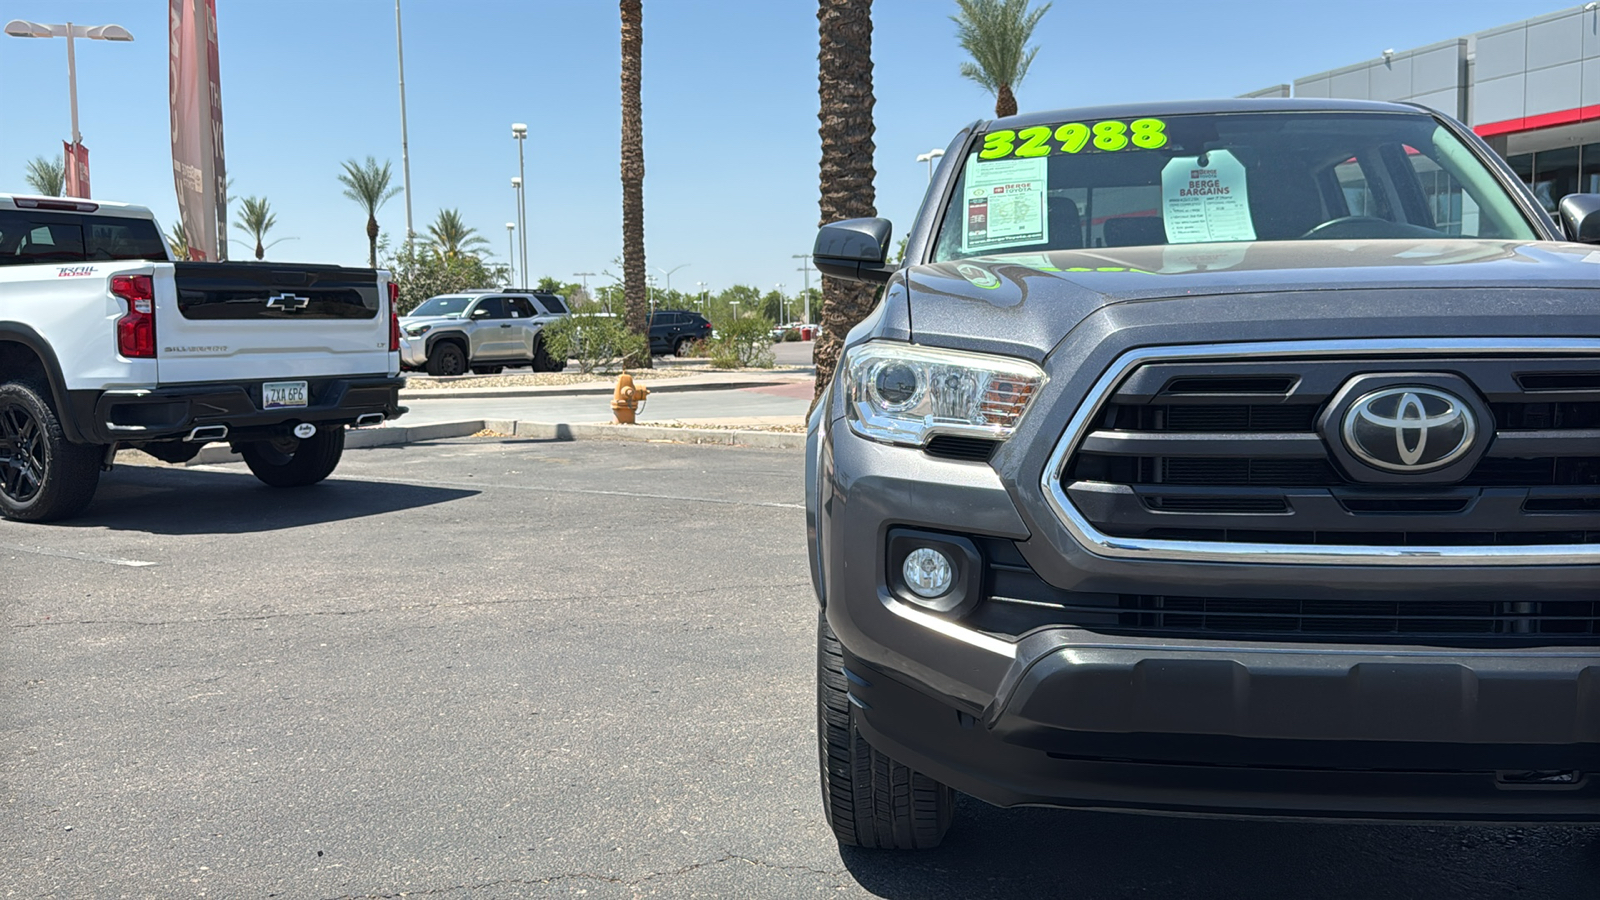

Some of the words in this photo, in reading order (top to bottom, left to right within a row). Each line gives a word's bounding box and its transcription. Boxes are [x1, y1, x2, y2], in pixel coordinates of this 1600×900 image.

[979, 118, 1167, 160] 32988
[1189, 180, 1220, 189] BERGE
[1180, 187, 1230, 197] BARGAINS
[270, 388, 286, 402] ZXA
[288, 388, 304, 401] 6P6
